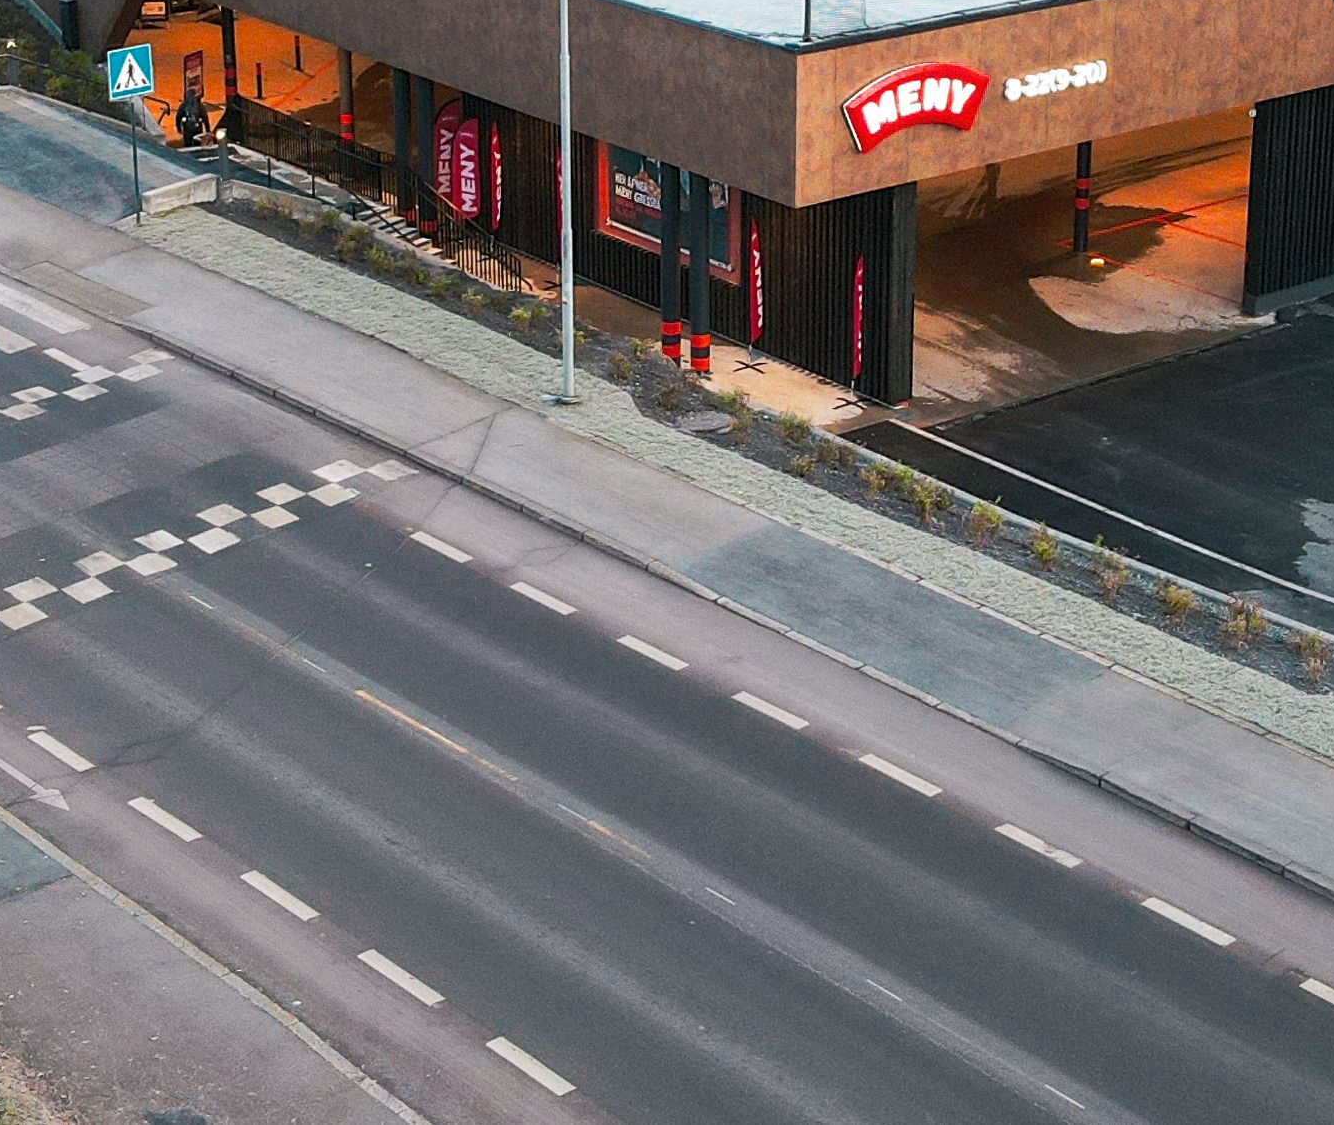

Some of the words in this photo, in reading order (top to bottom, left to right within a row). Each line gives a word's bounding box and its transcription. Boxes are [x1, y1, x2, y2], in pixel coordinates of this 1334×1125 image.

[862, 77, 976, 135] MENY
[437, 129, 454, 194] MENY
[460, 143, 478, 213] MENY
